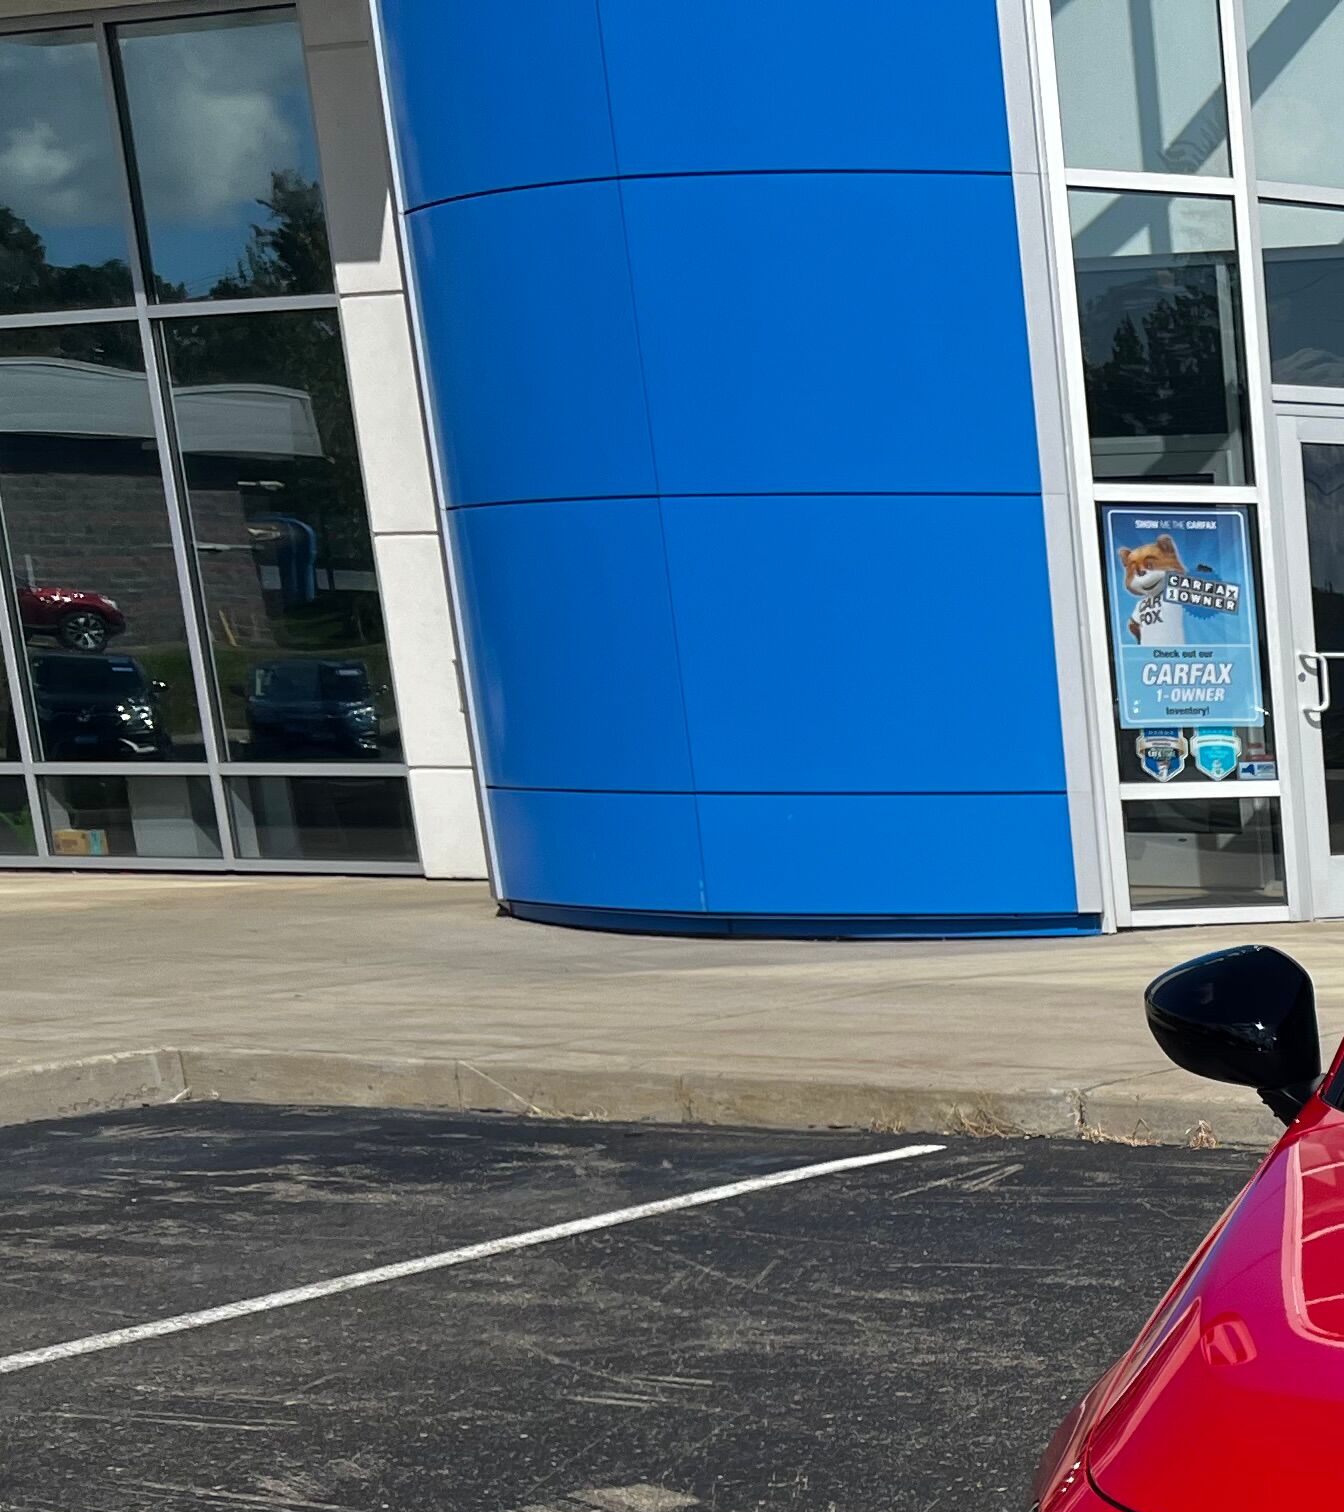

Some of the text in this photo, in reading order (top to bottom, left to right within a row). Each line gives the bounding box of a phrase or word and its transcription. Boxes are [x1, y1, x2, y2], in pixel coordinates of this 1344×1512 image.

[1186, 520, 1217, 530] CARFAX
[1169, 576, 1240, 599] CARFAX
[1153, 649, 1180, 658] Check
[1182, 650, 1196, 658] out
[1142, 663, 1233, 686] CARFAX
